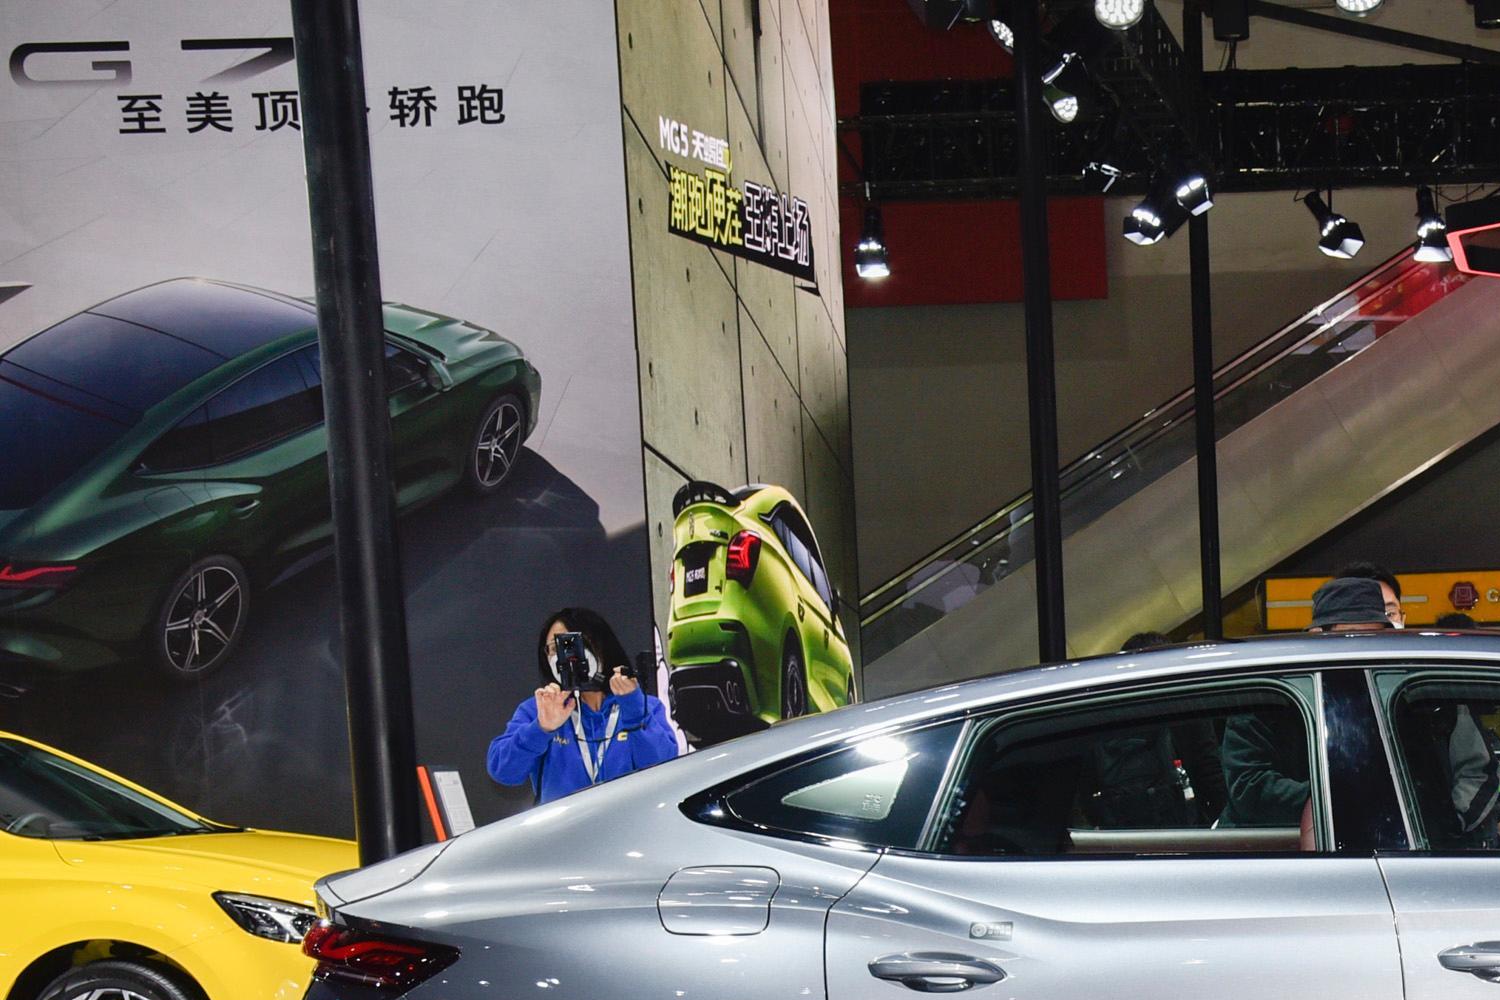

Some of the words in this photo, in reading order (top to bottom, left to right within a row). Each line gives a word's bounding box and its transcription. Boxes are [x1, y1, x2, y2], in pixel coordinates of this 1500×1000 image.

[116, 84, 506, 135] 至美顶轿跑
[659, 115, 688, 157] MG5
